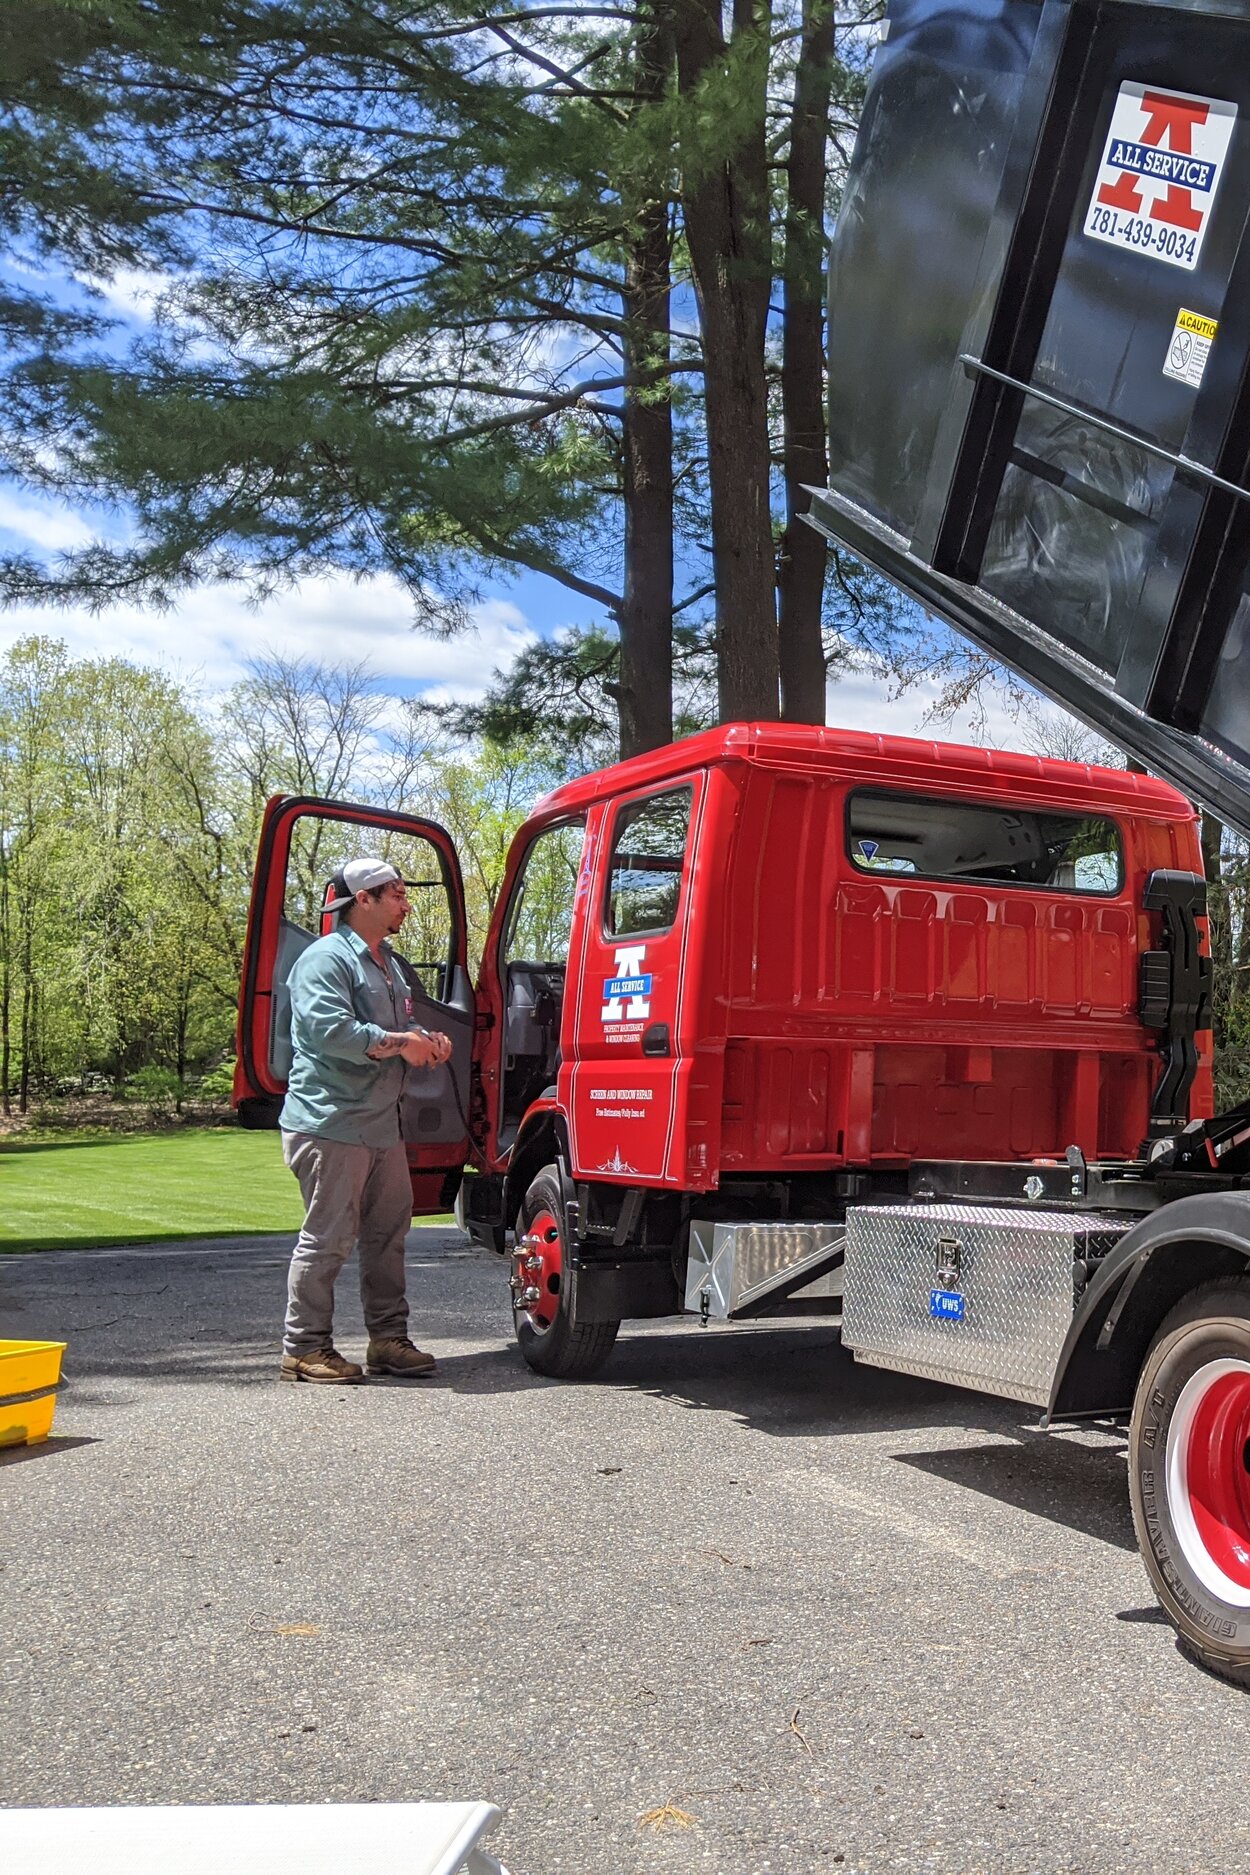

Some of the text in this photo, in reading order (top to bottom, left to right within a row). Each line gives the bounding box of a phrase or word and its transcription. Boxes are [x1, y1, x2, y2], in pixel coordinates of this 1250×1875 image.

[1111, 143, 1210, 187] ALL SERVICE
[1090, 207, 1198, 263] 781-439-9034
[1185, 316, 1216, 337] CAUTIO
[609, 979, 645, 994] ALL SERVICE
[942, 1297, 959, 1312] UWS
